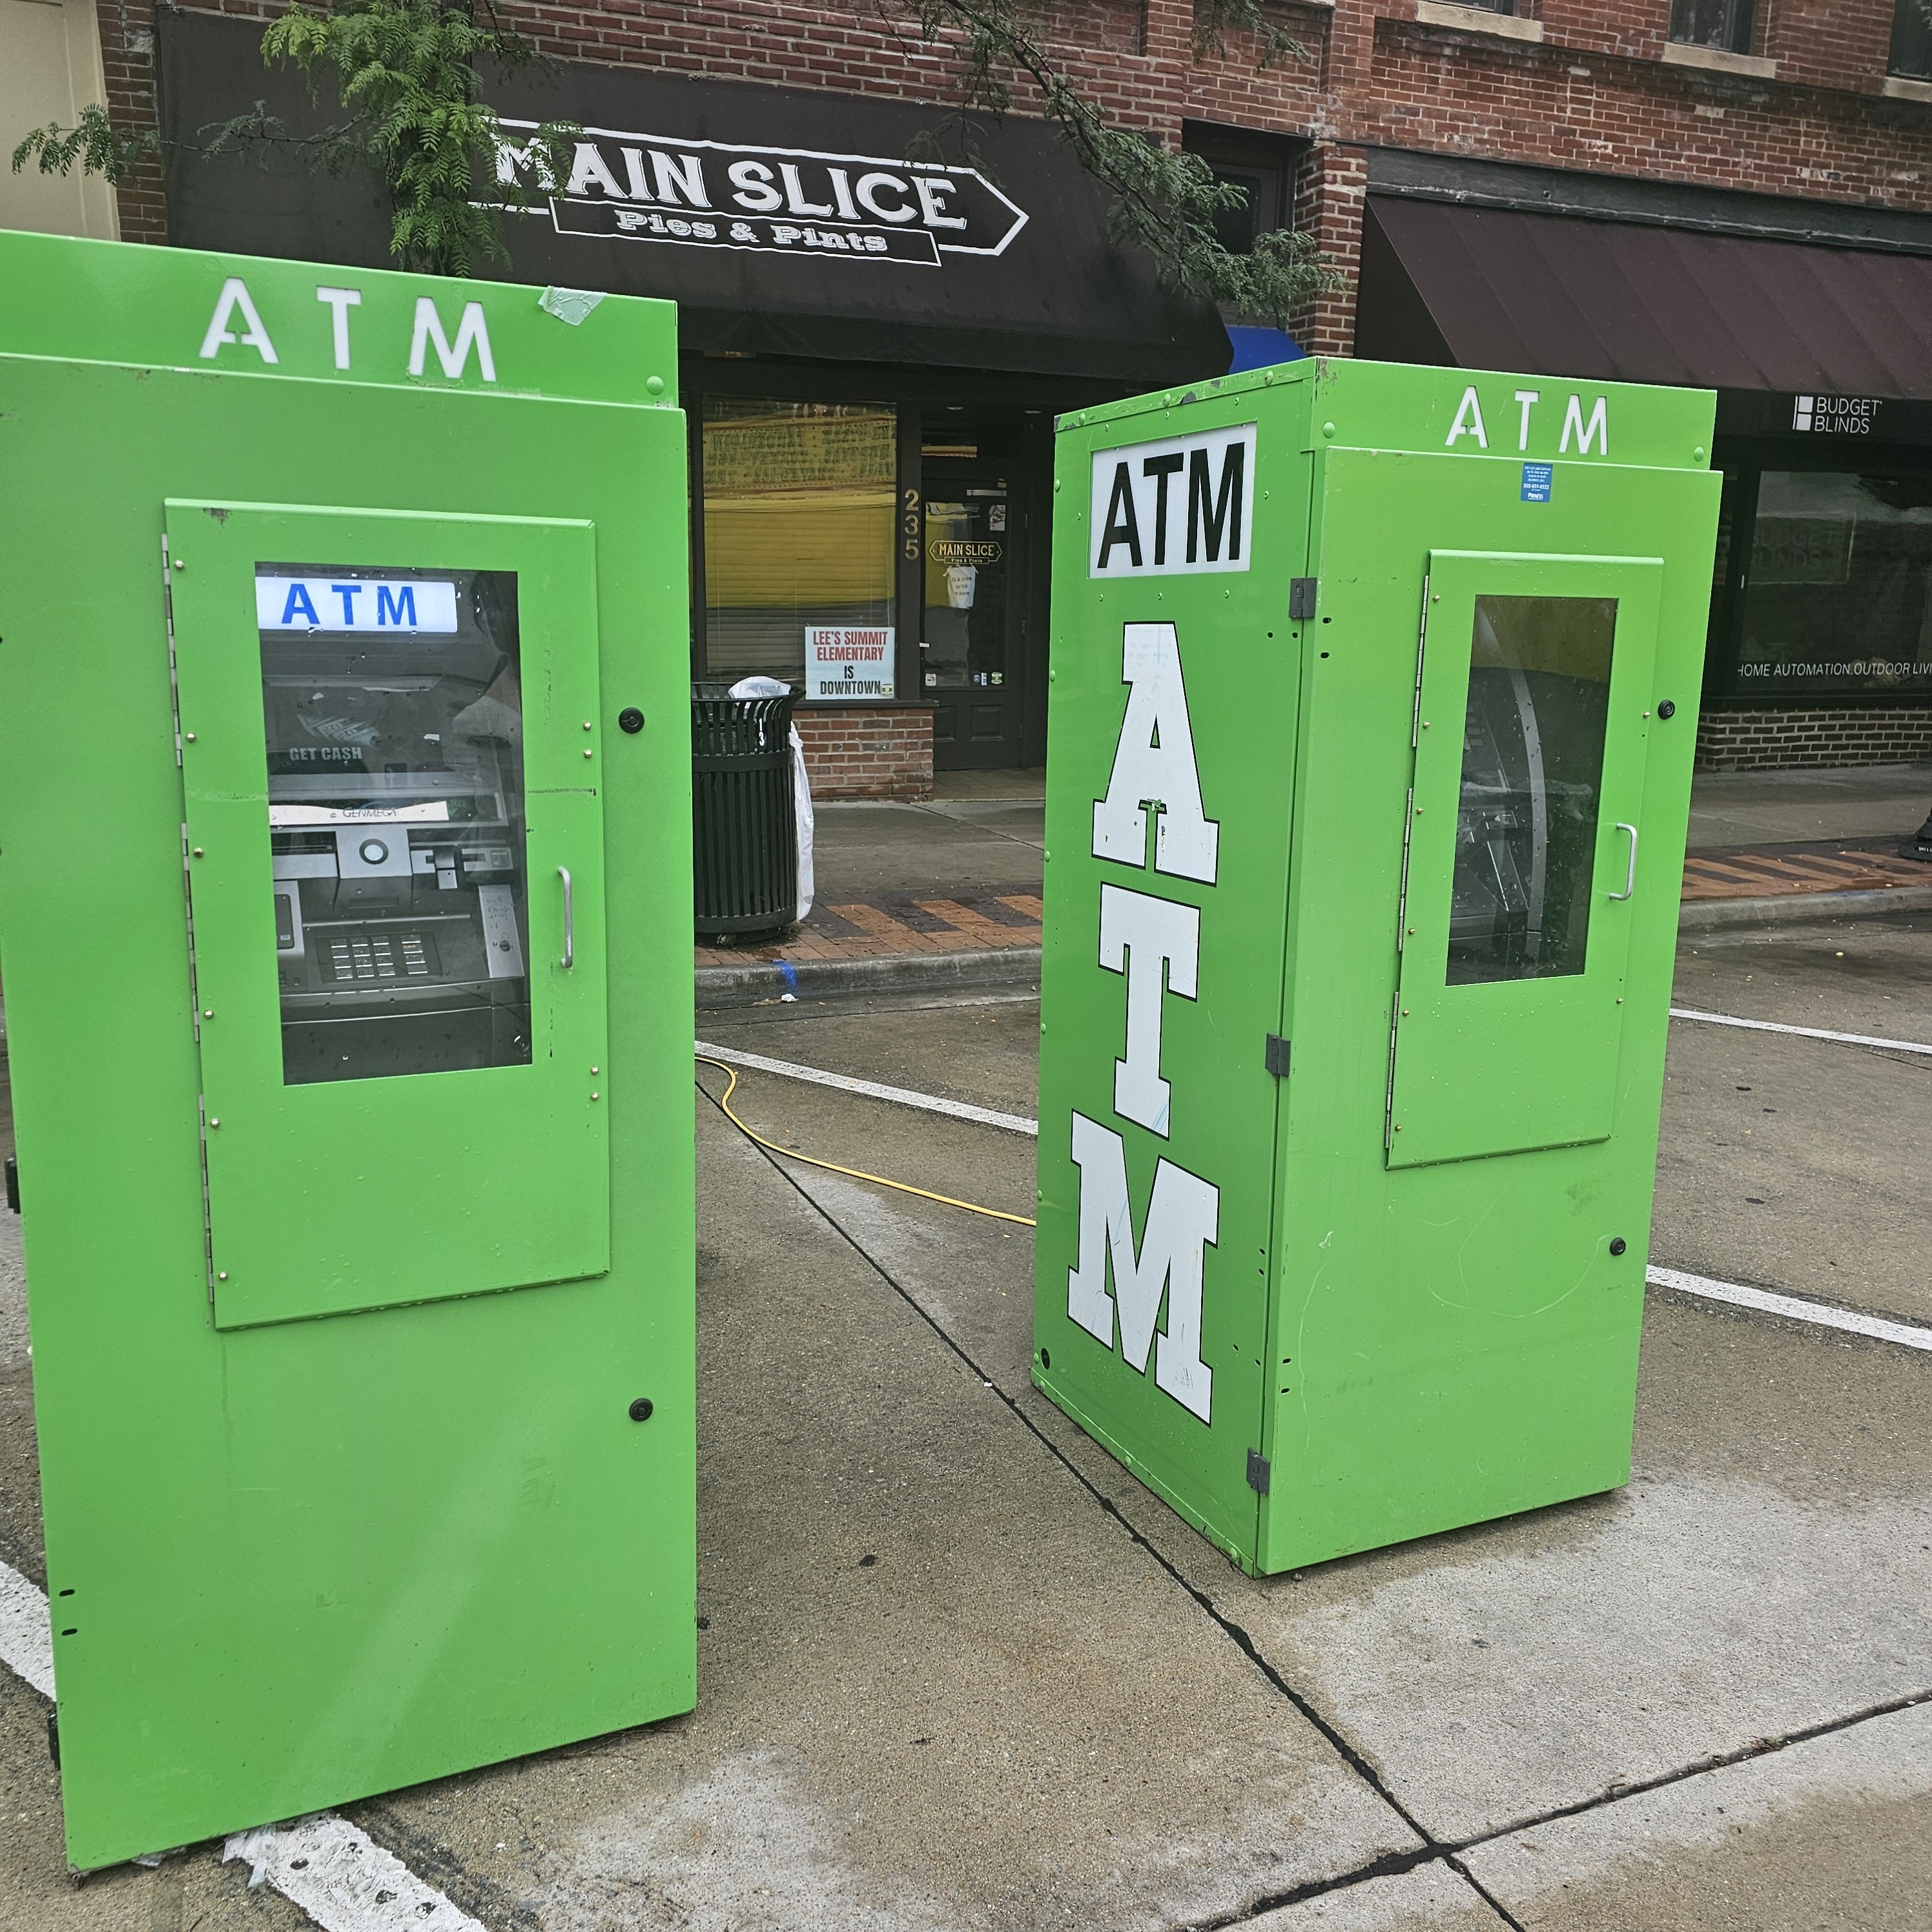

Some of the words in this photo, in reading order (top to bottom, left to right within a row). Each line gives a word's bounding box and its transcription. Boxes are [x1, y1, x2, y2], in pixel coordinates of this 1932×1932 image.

[489, 133, 712, 207] MAIN
[728, 159, 967, 230] SLICE
[614, 209, 717, 239] Pies
[730, 222, 761, 243] &
[770, 224, 888, 251] Pints
[199, 276, 497, 382] ATM
[1816, 396, 1880, 416] BUDGET
[1444, 385, 1608, 455] ATM
[1814, 415, 1870, 434] BLINDS
[1097, 442, 1246, 569] ATM
[905, 489, 919, 560] 235
[939, 544, 963, 555] MAIN
[965, 544, 994, 556] SLICE
[282, 583, 417, 626] ATM
[813, 631, 841, 645] LEE'S
[844, 631, 888, 645] SUMMIT
[817, 646, 883, 661] ELEMENTARY
[844, 665, 854, 679] IS
[820, 680, 881, 695] DOWNTOWN
[290, 747, 316, 761] GET
[321, 746, 362, 760] CASH
[342, 807, 396, 818] GENMEGA
